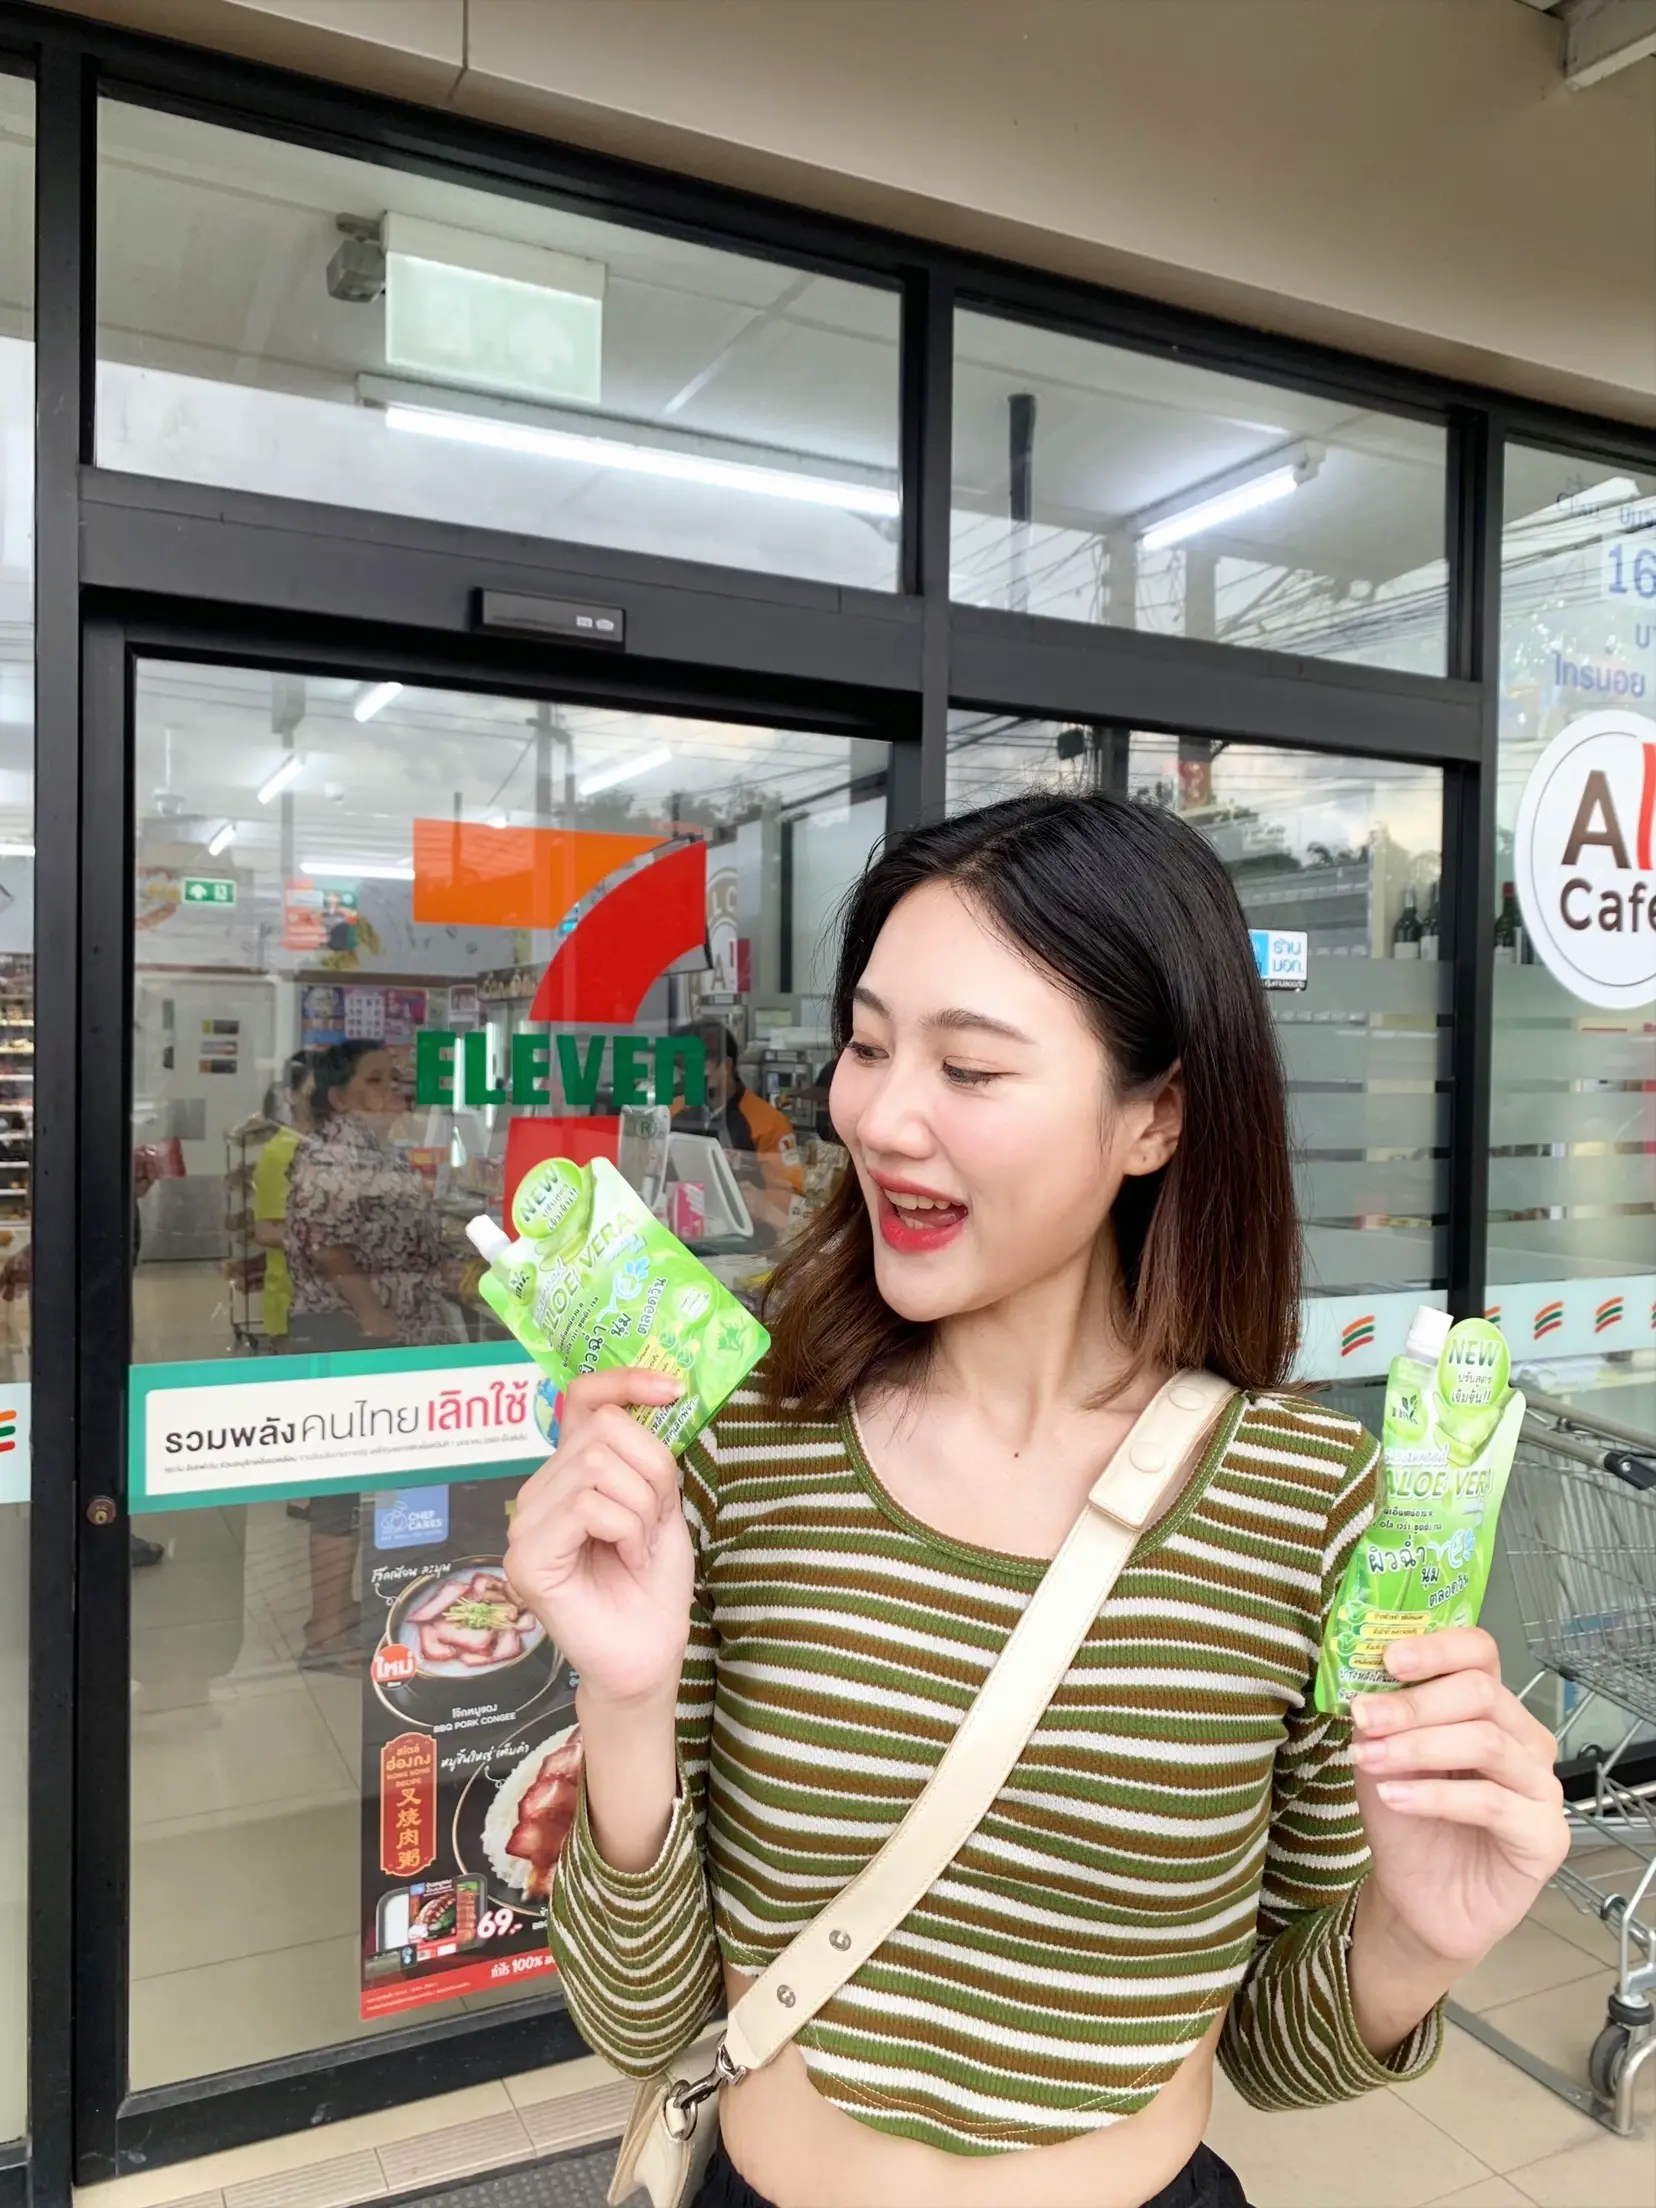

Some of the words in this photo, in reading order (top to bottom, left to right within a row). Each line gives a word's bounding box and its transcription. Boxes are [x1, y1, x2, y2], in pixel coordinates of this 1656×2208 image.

[518, 1165, 562, 1223] NEW
[579, 1209, 639, 1271] VERA
[1448, 1338, 1501, 1368] NEW
[408, 1509, 436, 1522] CHEF
[408, 1518, 443, 1532] CARES
[376, 1651, 415, 1679] ใหม่
[433, 1724, 454, 1734] BBQ
[454, 1719, 480, 1730] PORK
[480, 1711, 517, 1725] CONGEE
[386, 1753, 431, 1772] ฮ่องกง
[511, 1956, 543, 1975] 100%
